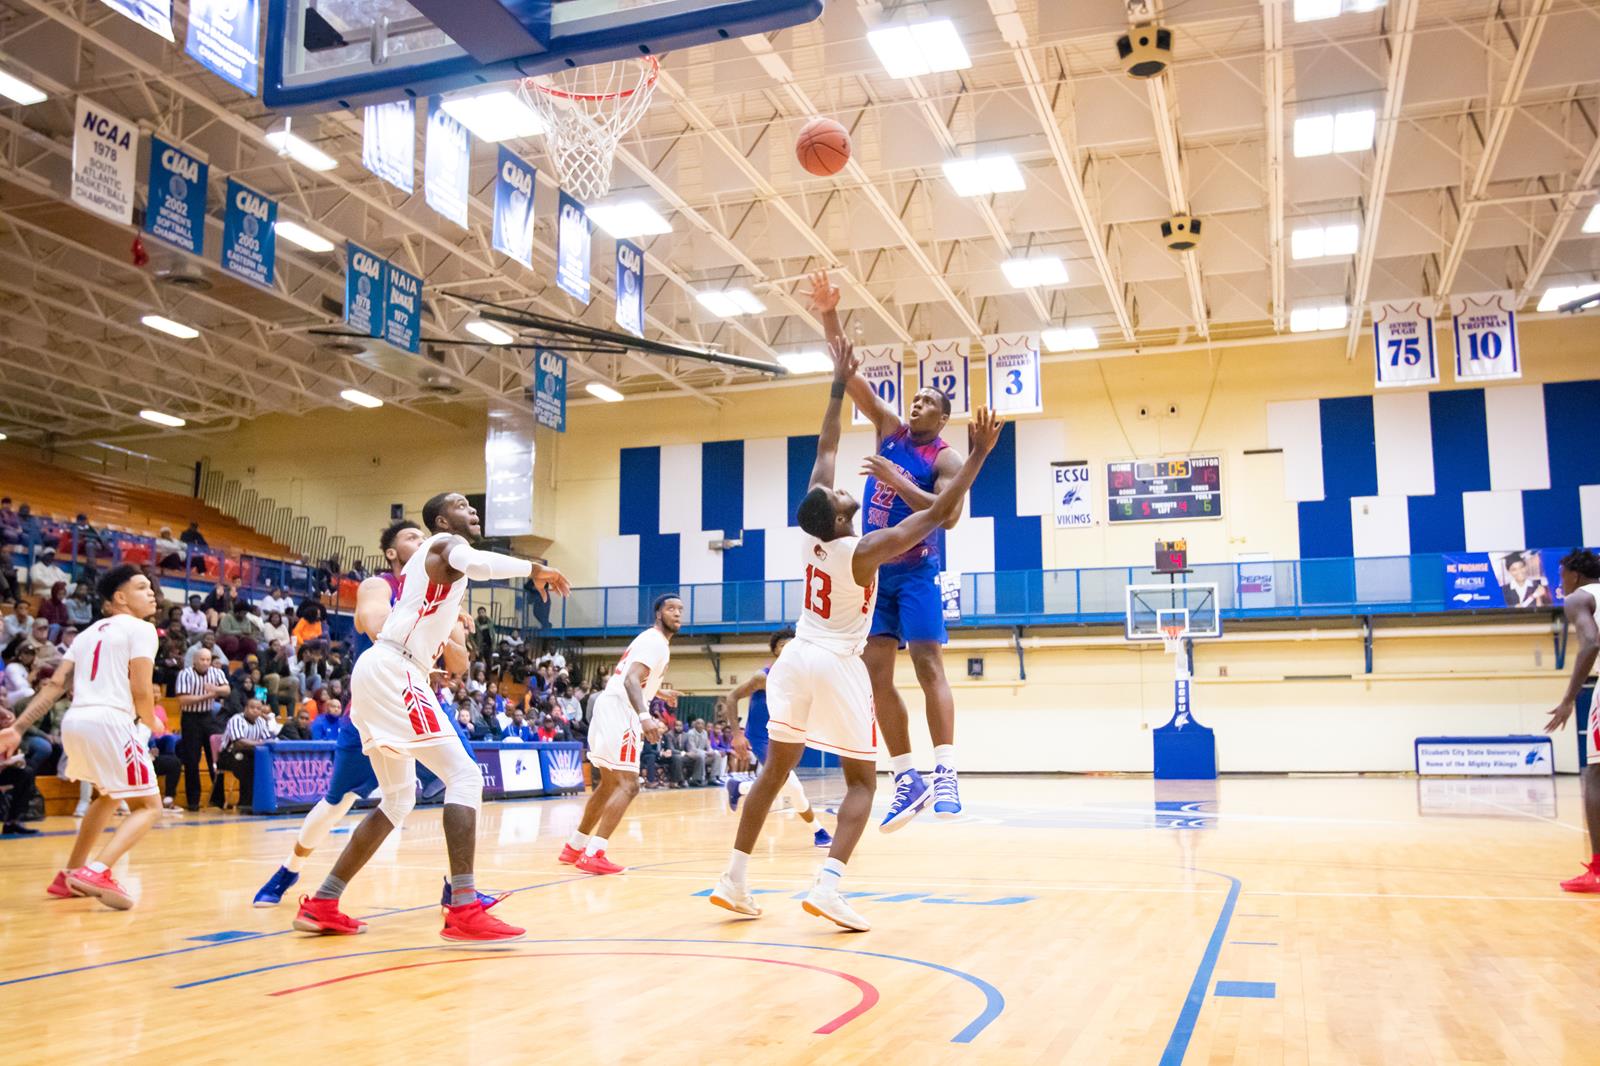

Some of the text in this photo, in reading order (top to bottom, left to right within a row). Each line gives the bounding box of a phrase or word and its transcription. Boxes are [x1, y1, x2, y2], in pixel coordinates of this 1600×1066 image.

[83, 111, 131, 150] NCAA
[93, 141, 117, 162] 1978
[83, 166, 122, 191] ATLANTIC
[89, 157, 118, 178] SOUTH
[161, 149, 199, 184] CIAA
[502, 160, 532, 198] CIAA
[75, 173, 128, 204] BASKETBALL
[75, 186, 126, 216] CHAMPIONS
[165, 194, 188, 217] 2002
[236, 191, 269, 222] CIAA
[353, 252, 380, 280] CIAA
[618, 244, 641, 275] CIAA
[391, 269, 417, 295] NAIA
[1391, 328, 1416, 336] PUGH
[1461, 320, 1507, 330] TROTMAN
[1387, 337, 1421, 367] 75
[1467, 331, 1503, 361] 10
[540, 352, 563, 379] CIAA
[934, 365, 954, 373] GALE
[932, 374, 957, 400] 12
[1005, 369, 1023, 396] 3
[1055, 468, 1089, 484] ECSU
[1111, 464, 1131, 472] HOME
[1153, 460, 1187, 478] 1:05
[1191, 459, 1219, 468] VISITOR
[871, 481, 897, 509] 22
[1057, 513, 1091, 525] VIKINGS
[1170, 553, 1182, 569] 4
[805, 563, 832, 620] 13
[90, 640, 102, 682] 1
[1452, 749, 1465, 757] City
[1486, 749, 1520, 757] University
[274, 760, 334, 779] VIKING
